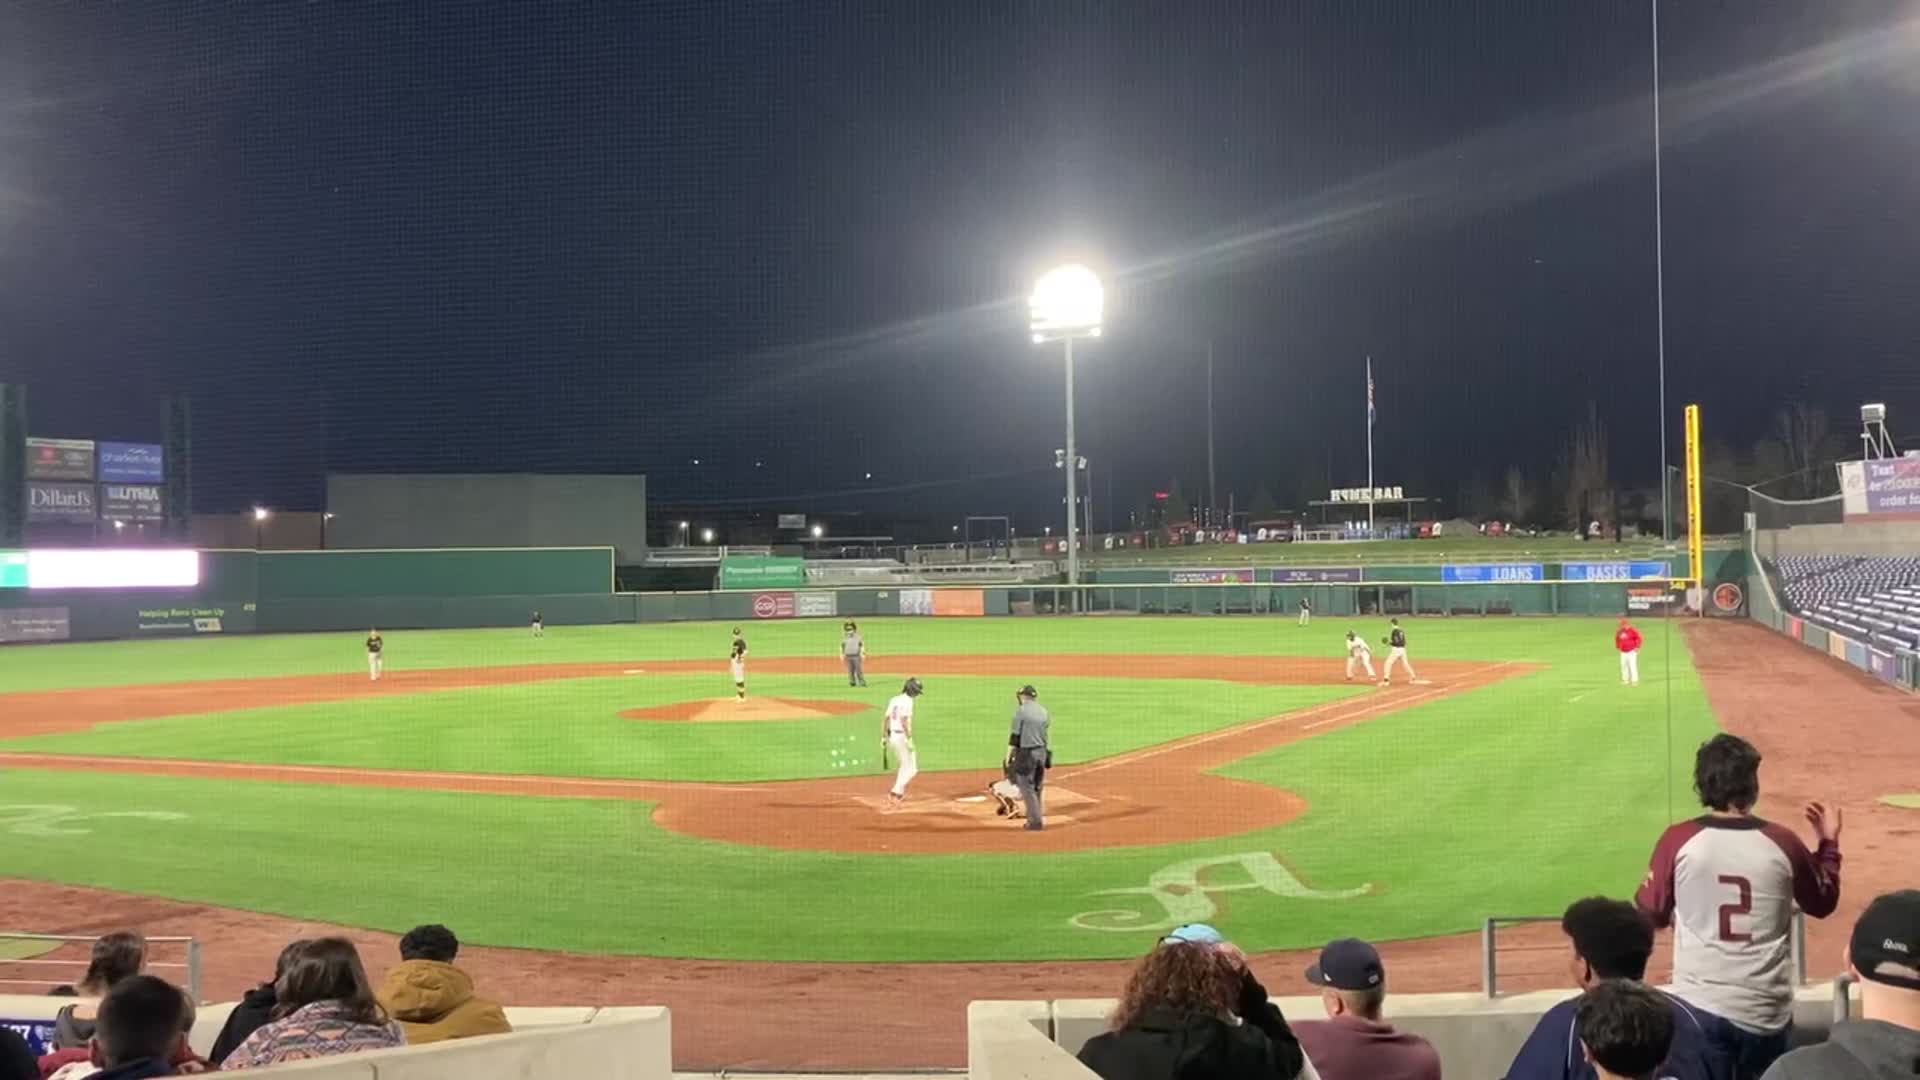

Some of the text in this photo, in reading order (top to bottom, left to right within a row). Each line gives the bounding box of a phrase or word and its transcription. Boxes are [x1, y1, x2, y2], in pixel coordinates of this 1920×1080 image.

[1871, 463, 1895, 477] Text
[30, 487, 91, 506] Dillard's
[1374, 486, 1403, 499] BAR
[1879, 494, 1907, 507] order
[1491, 566, 1534, 580] LOANS
[1718, 875, 1753, 942] 2
